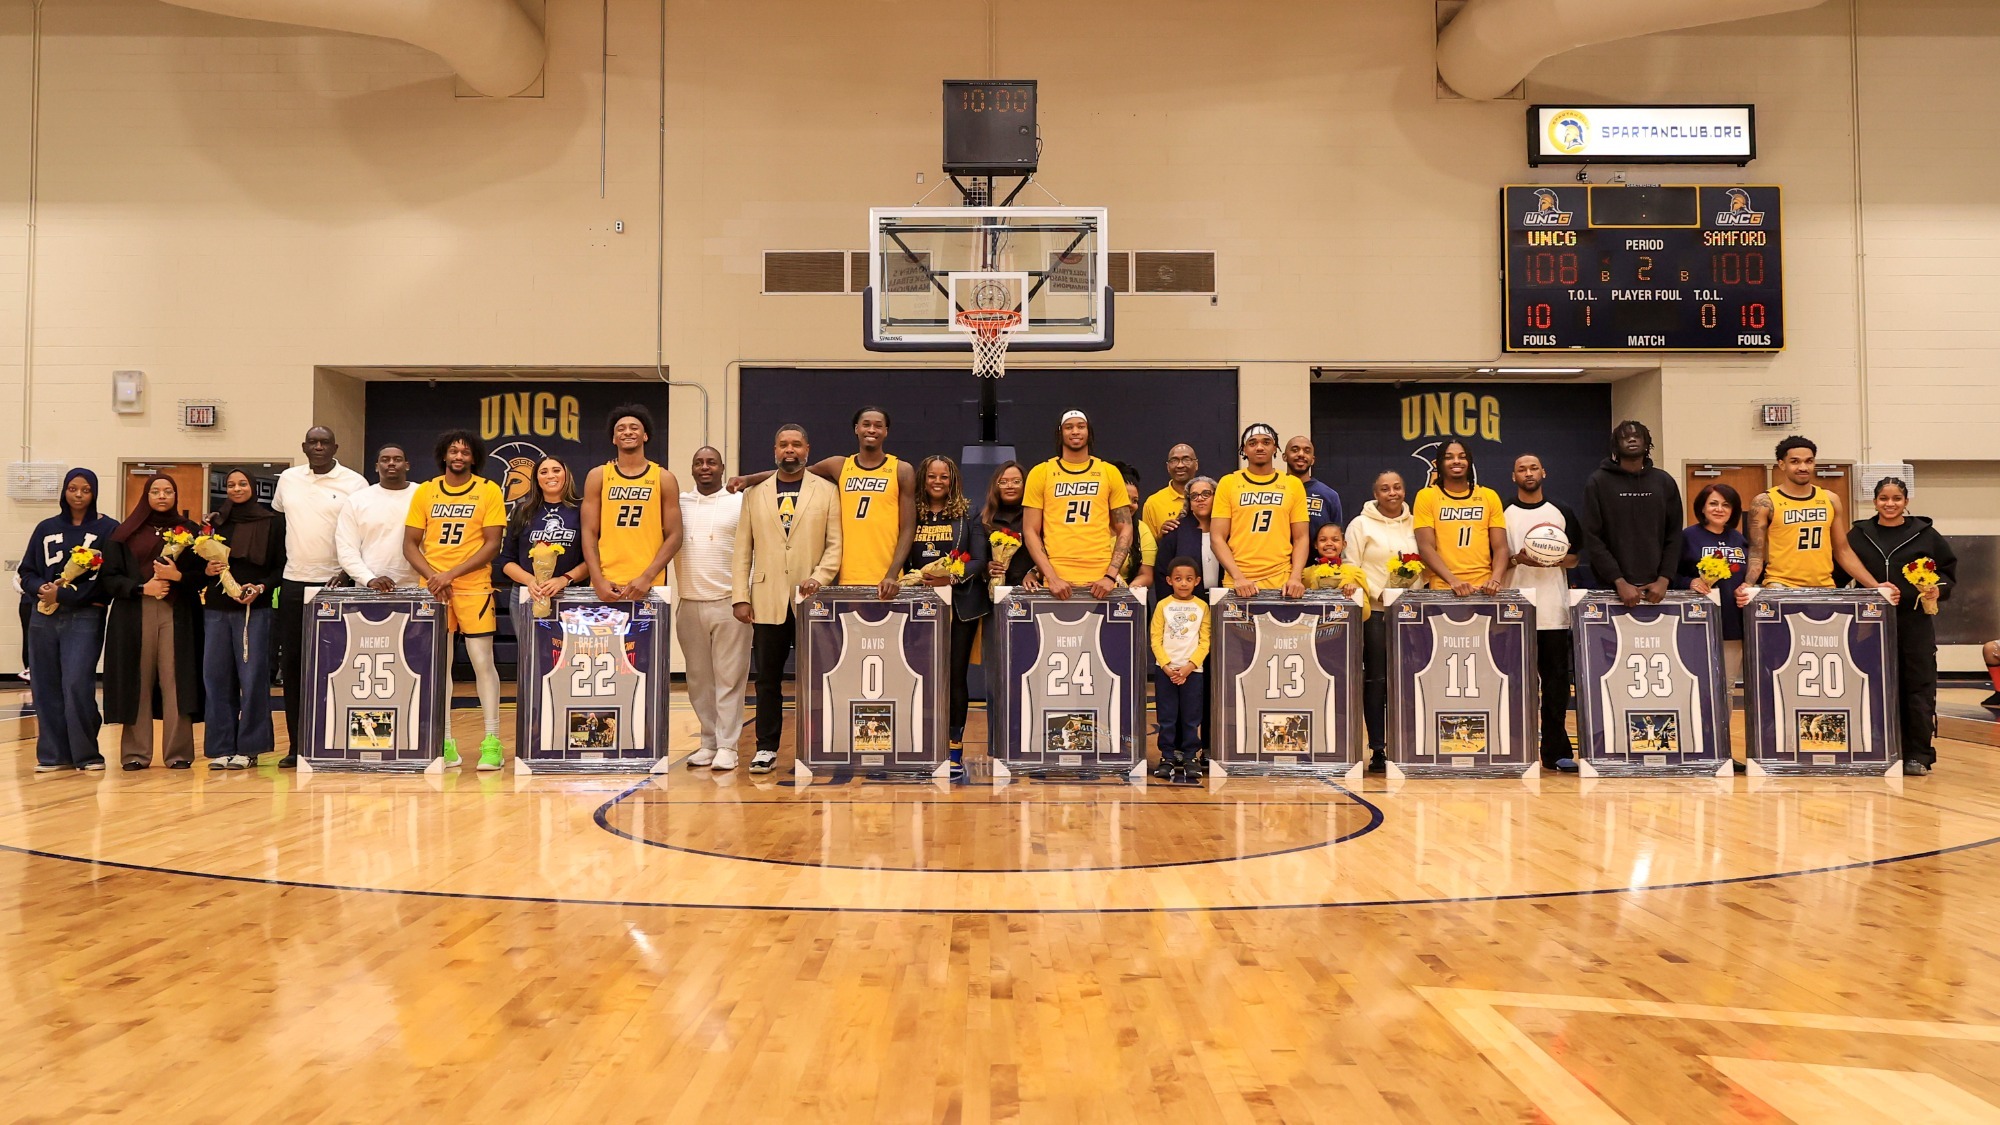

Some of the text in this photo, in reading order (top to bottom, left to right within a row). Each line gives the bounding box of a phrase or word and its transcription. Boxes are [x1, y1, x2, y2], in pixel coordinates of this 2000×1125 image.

[963, 89, 1027, 113] 10:00
[1601, 126, 1742, 139] SPARTANCLUB.ORG
[1525, 213, 1571, 225] UNCG
[1717, 213, 1762, 225] UNCG
[1528, 231, 1577, 246] UNCG
[1625, 239, 1664, 250] PERIOD
[1703, 231, 1766, 246] SAMFORD
[1526, 253, 1578, 285] 108
[1638, 256, 1653, 281] 2
[1712, 253, 1764, 285] 100
[1568, 290, 1598, 301] T.O.L.
[1611, 290, 1683, 301] PLAYER FOUL
[1693, 290, 1724, 301] T.O.L.
[1527, 303, 1551, 329] 10
[1586, 305, 1591, 327] 1
[1701, 303, 1716, 329] 0
[1741, 303, 1765, 329] 10
[1523, 335, 1557, 346] FOULS
[1628, 335, 1666, 347] MATCH
[1737, 335, 1771, 346] FOULS
[190, 408, 210, 424] EXIT
[480, 391, 582, 444] UNCG
[1400, 391, 1503, 444] UNCG
[1768, 406, 1788, 422] EXIT
[845, 477, 889, 492] UNCG
[1054, 482, 1100, 497] UNCG
[608, 486, 653, 501] UNCG
[1240, 491, 1284, 506] UNCG
[431, 504, 476, 519] UNCG
[855, 496, 871, 519] 0
[1065, 500, 1091, 523] 24
[1439, 506, 1484, 521] UNCG
[616, 505, 643, 527] 22
[1252, 510, 1273, 532] 13
[1783, 507, 1827, 525] UNCG
[439, 522, 465, 545] 35
[531, 530, 574, 542] UNCG
[914, 533, 953, 542] ASKETBALL
[1458, 526, 1472, 547] 11
[1797, 526, 1822, 550] 20
[359, 636, 390, 649] AHEMED
[861, 637, 885, 650] DAVIS
[1056, 635, 1083, 648] HENRY
[1273, 637, 1298, 650] JONES
[1443, 635, 1480, 648] POLITE III
[1634, 636, 1661, 649] REATH
[1800, 634, 1839, 648] SAIZONOU
[351, 652, 396, 700] 35
[570, 652, 616, 697] 22
[860, 654, 884, 699] 0
[1046, 651, 1094, 696] 24
[1265, 653, 1306, 699] 13
[1445, 652, 1480, 698] 11
[1626, 652, 1674, 698] 33
[1796, 651, 1846, 698] 20
